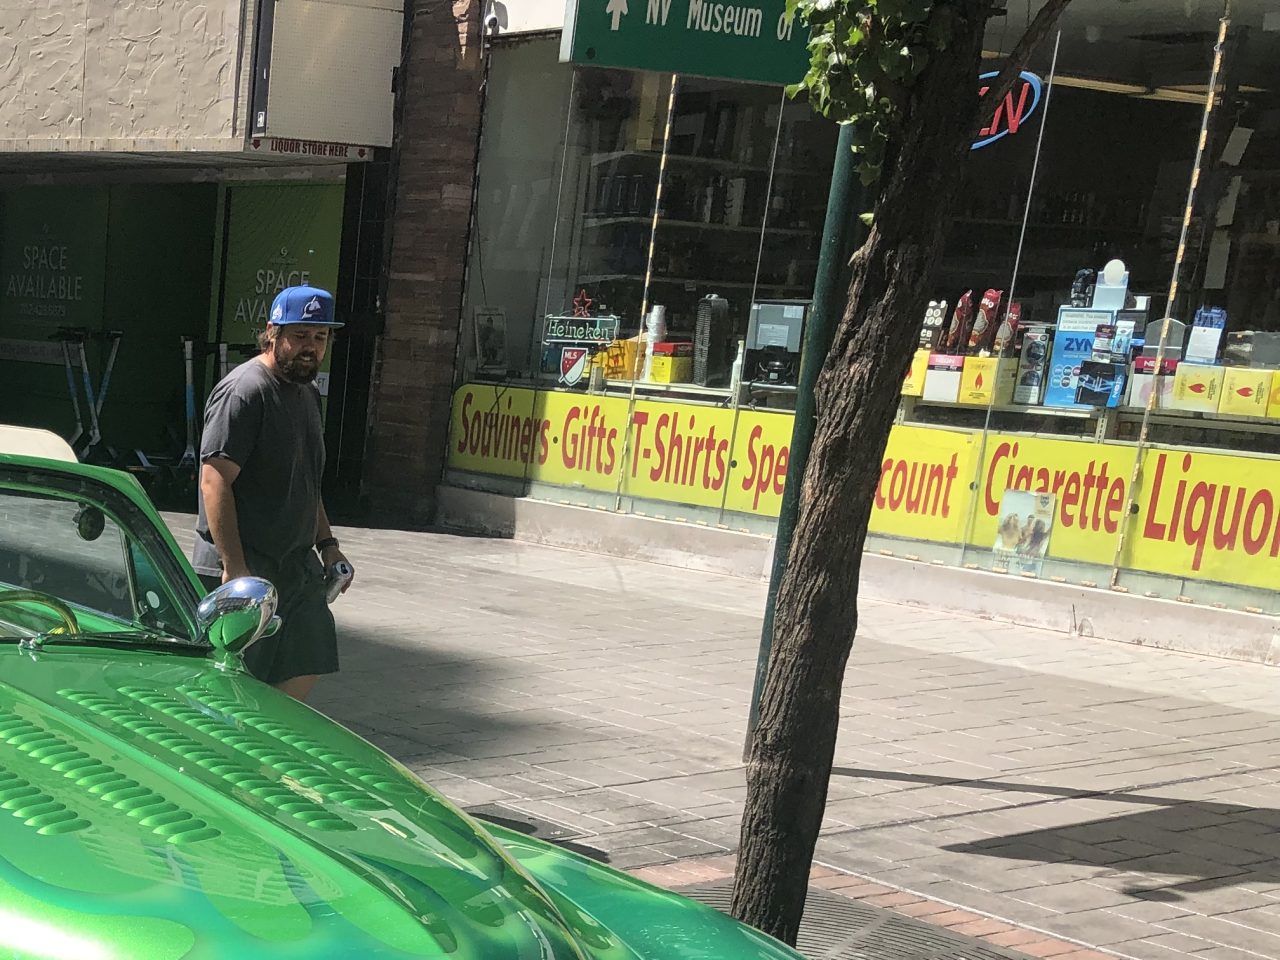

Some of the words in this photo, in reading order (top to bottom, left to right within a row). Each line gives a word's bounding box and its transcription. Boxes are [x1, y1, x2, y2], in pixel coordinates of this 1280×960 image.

[687, 0, 762, 37] Museum
[270, 139, 300, 154] LIQUOR
[302, 143, 327, 156] STORE
[329, 145, 348, 157] HERE
[23, 246, 67, 270] SPACE
[6, 274, 82, 300] AVAILABLE
[255, 269, 310, 294] SPACE
[547, 319, 610, 340] Heineken
[564, 351, 577, 360] MLS
[458, 392, 551, 466] Souviners
[562, 405, 617, 476] Gifts
[631, 411, 729, 491] T-Shirts
[875, 452, 958, 518] count
